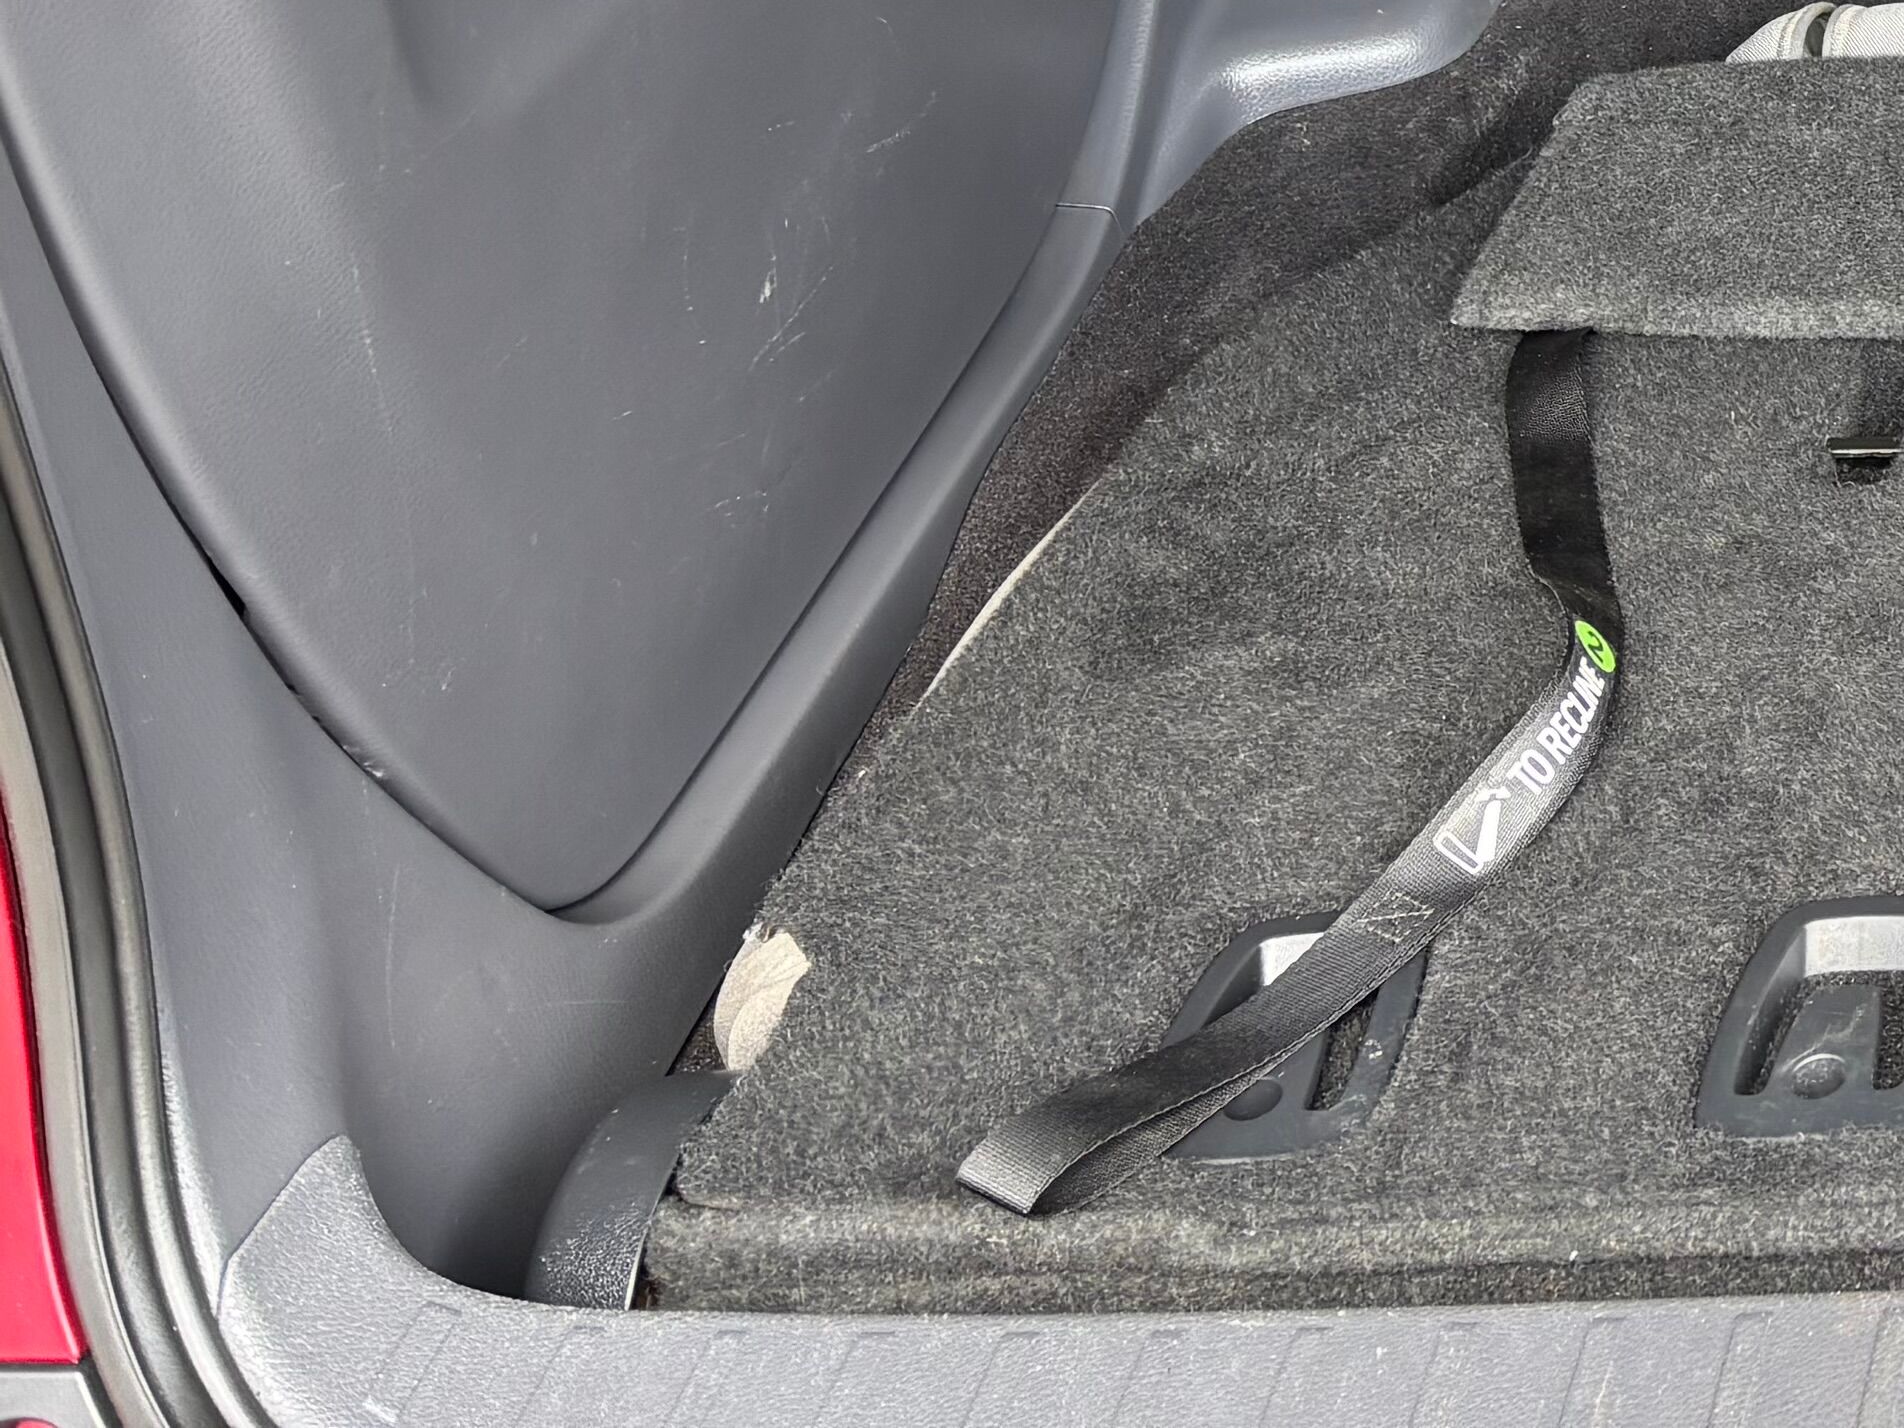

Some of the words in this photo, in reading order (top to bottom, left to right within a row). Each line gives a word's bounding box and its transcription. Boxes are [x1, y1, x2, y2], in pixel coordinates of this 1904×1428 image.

[1586, 630, 1604, 663] 2
[1506, 749, 1556, 795] TO
[1536, 656, 1606, 765] RECLINE
